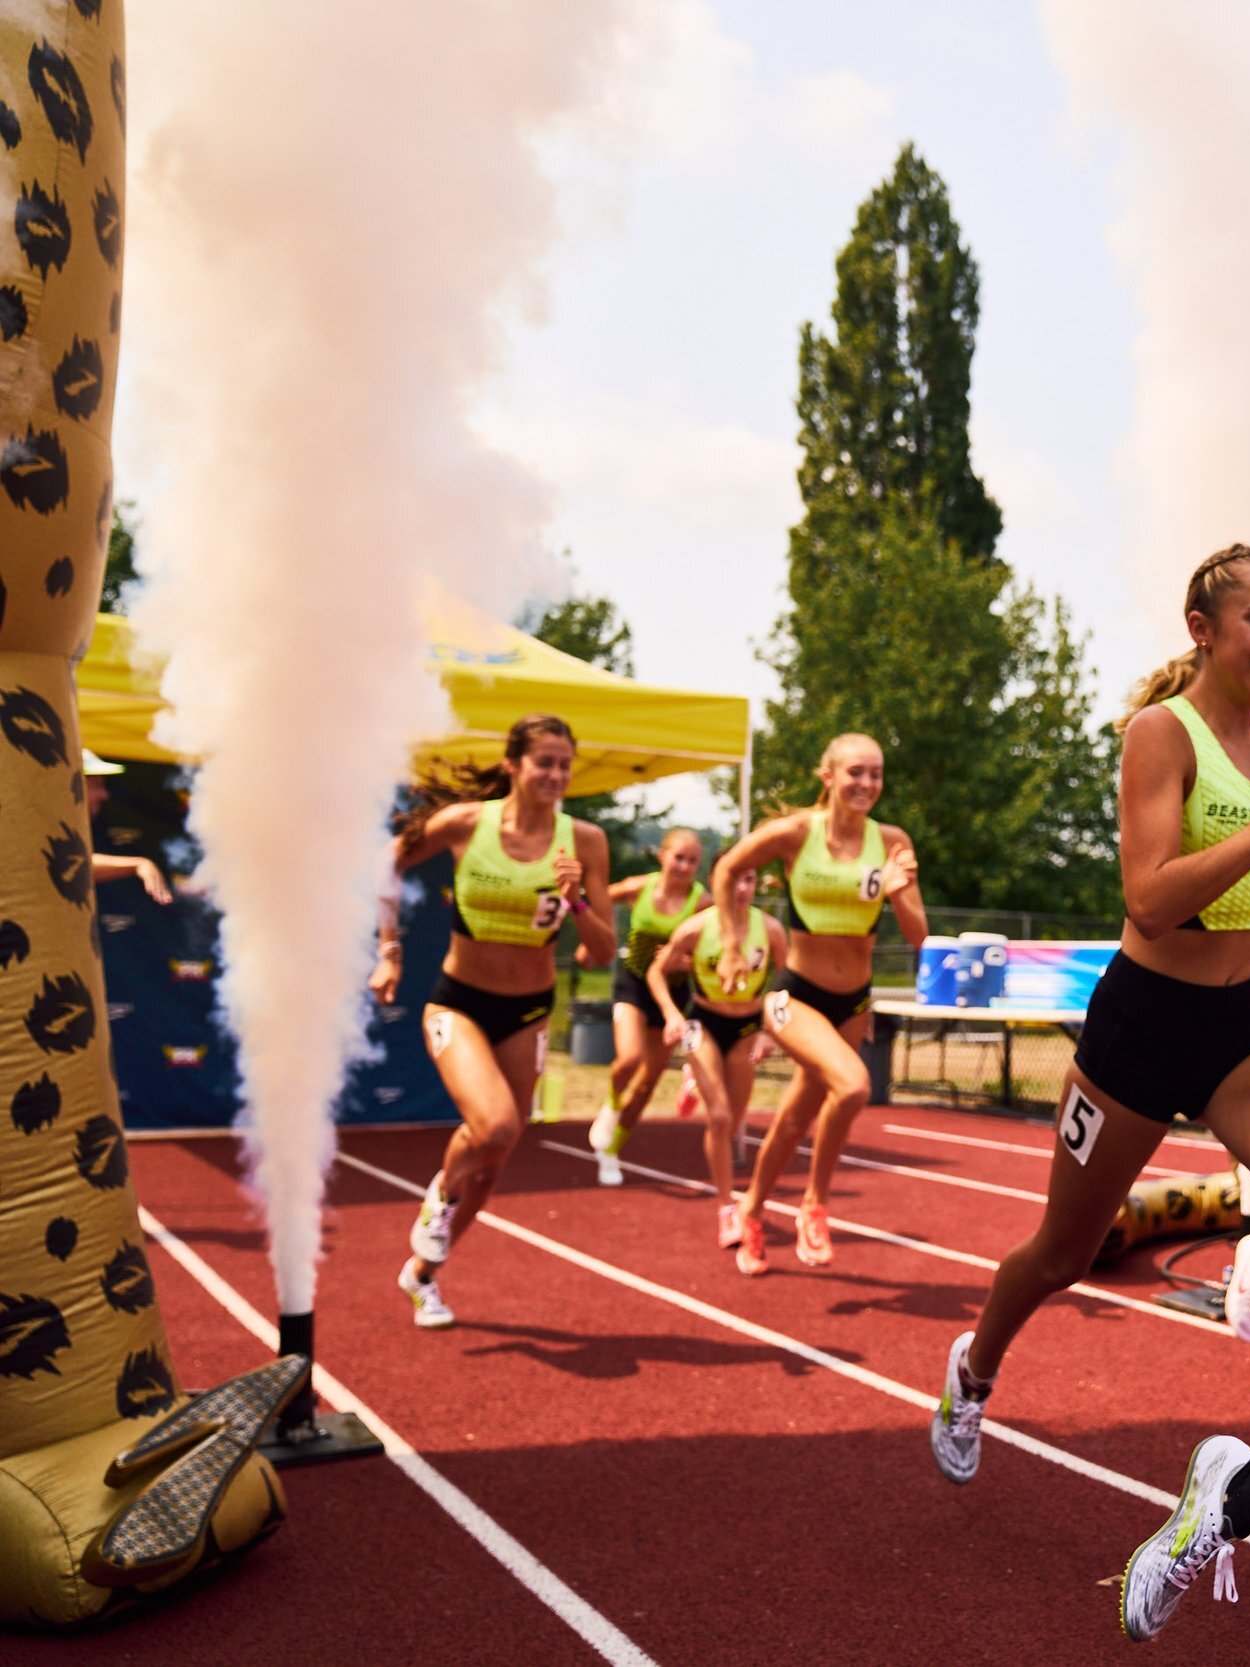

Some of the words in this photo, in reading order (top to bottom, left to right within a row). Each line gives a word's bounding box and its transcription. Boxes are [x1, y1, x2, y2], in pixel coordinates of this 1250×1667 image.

[867, 869, 882, 899] 6
[537, 896, 561, 928] 3
[1064, 1094, 1096, 1151] 5
